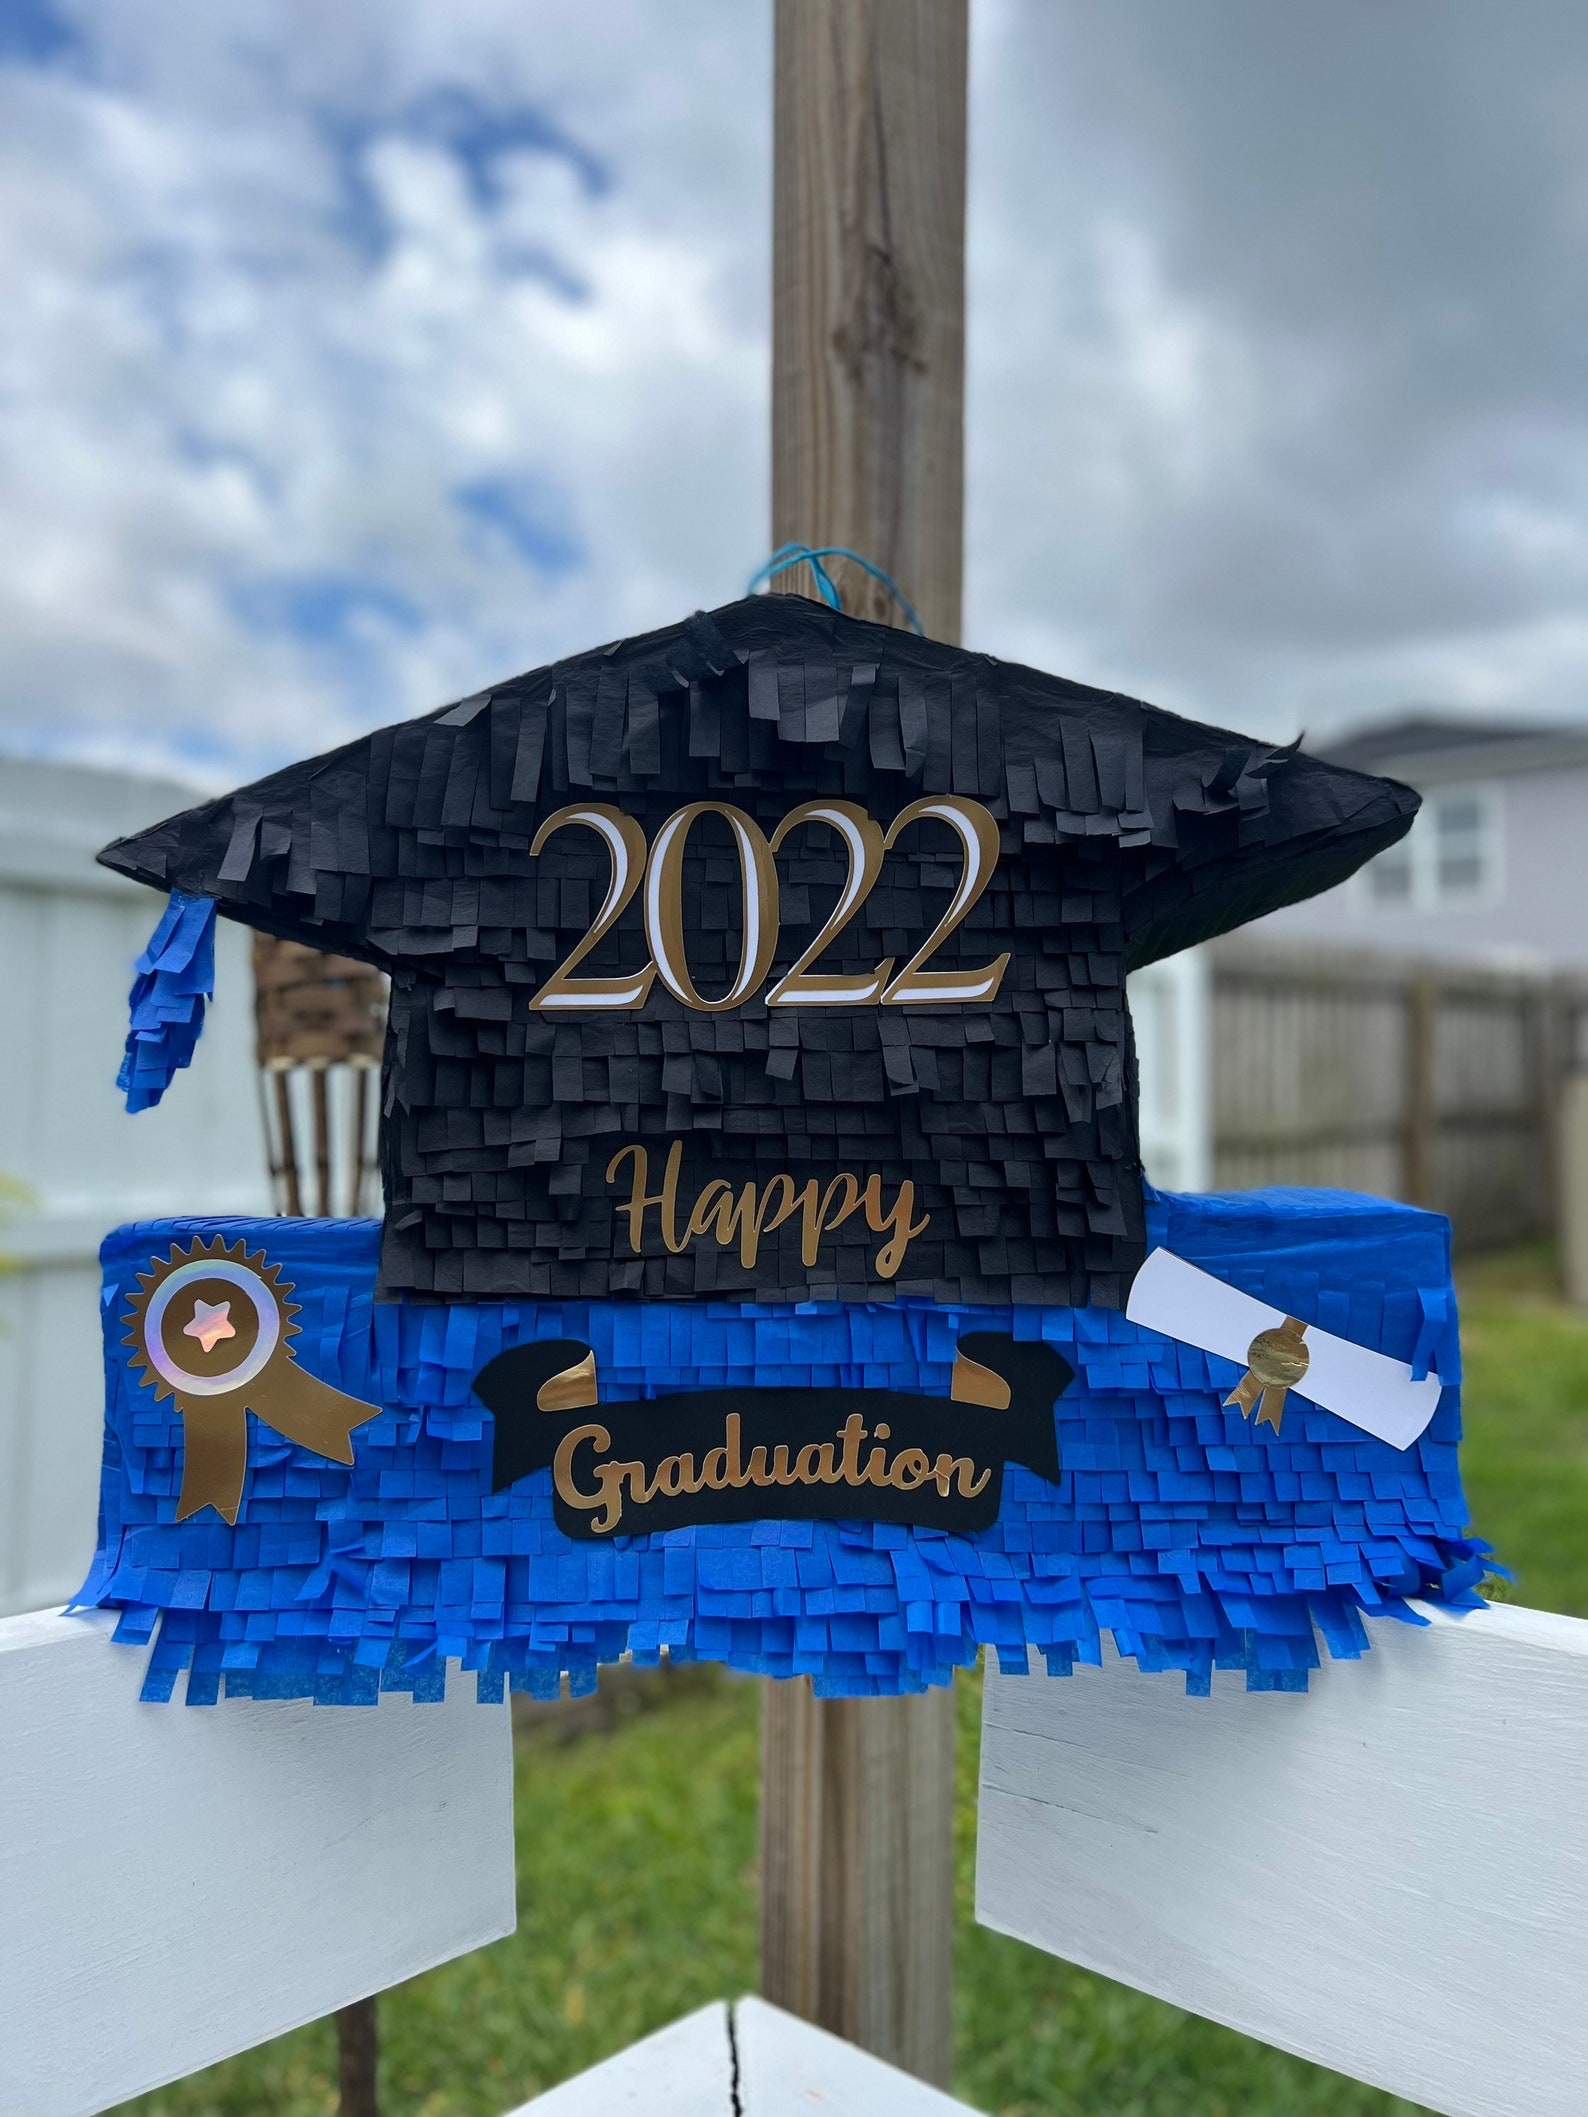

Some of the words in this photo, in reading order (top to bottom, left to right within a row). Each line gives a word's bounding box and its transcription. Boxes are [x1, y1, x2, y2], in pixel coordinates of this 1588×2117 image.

[528, 794, 1011, 1011] 2022
[606, 1140, 930, 1278] Happy
[553, 1413, 992, 1533] Graduation
